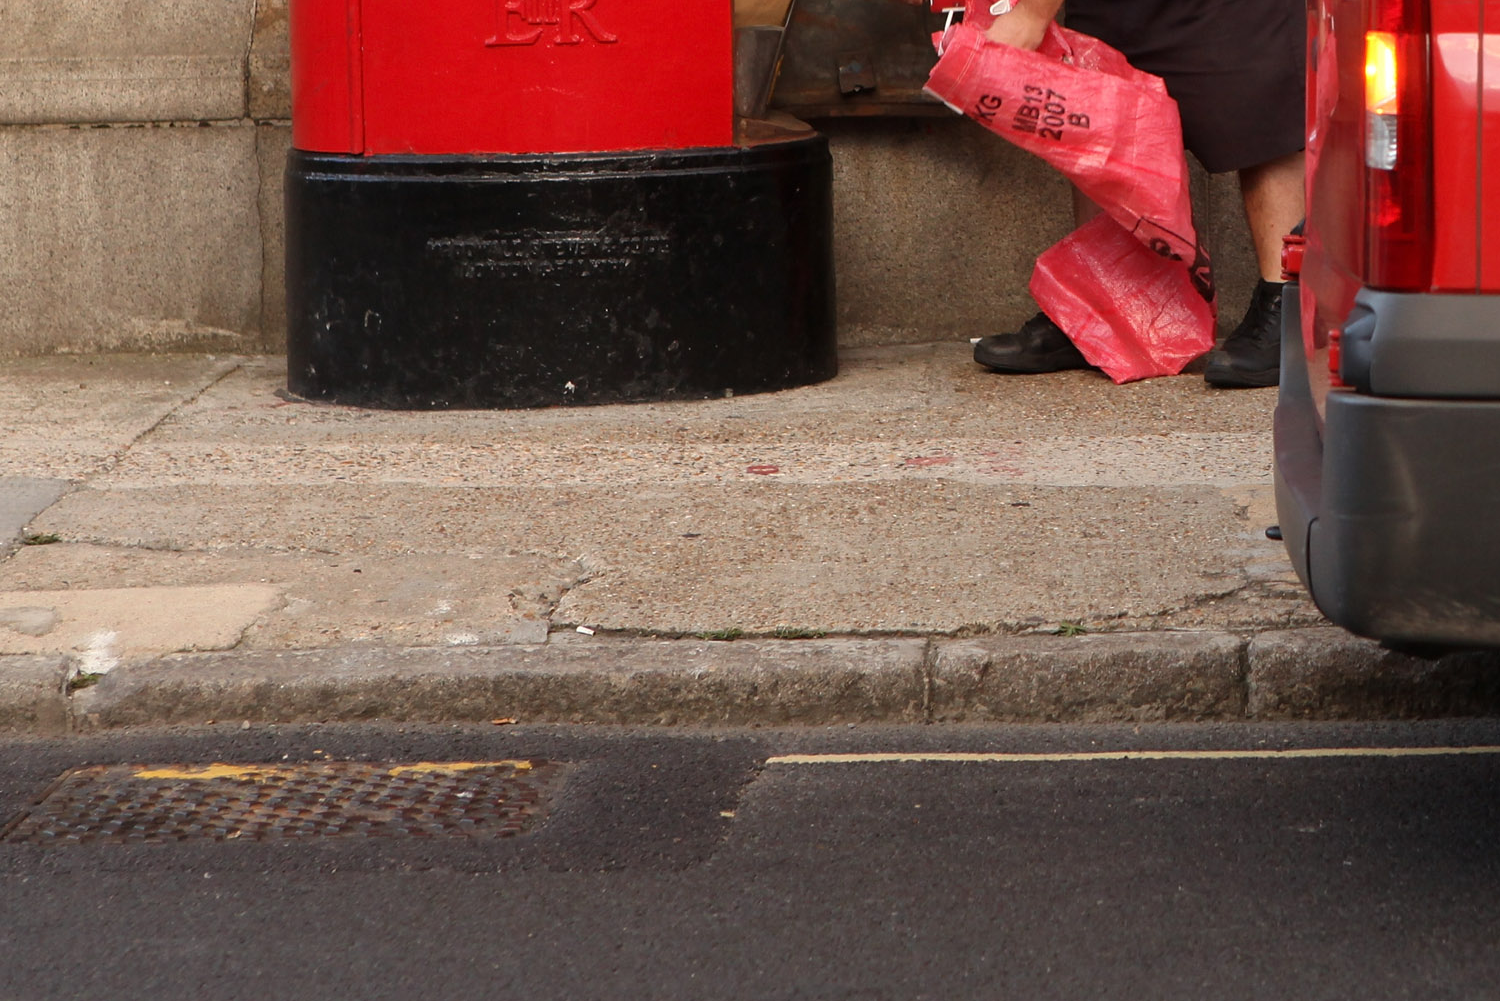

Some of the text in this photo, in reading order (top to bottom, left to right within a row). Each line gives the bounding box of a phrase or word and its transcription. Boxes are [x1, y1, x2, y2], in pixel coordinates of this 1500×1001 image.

[974, 94, 1002, 123] KG
[1039, 88, 1067, 141] 2007
[1067, 112, 1090, 130] B
